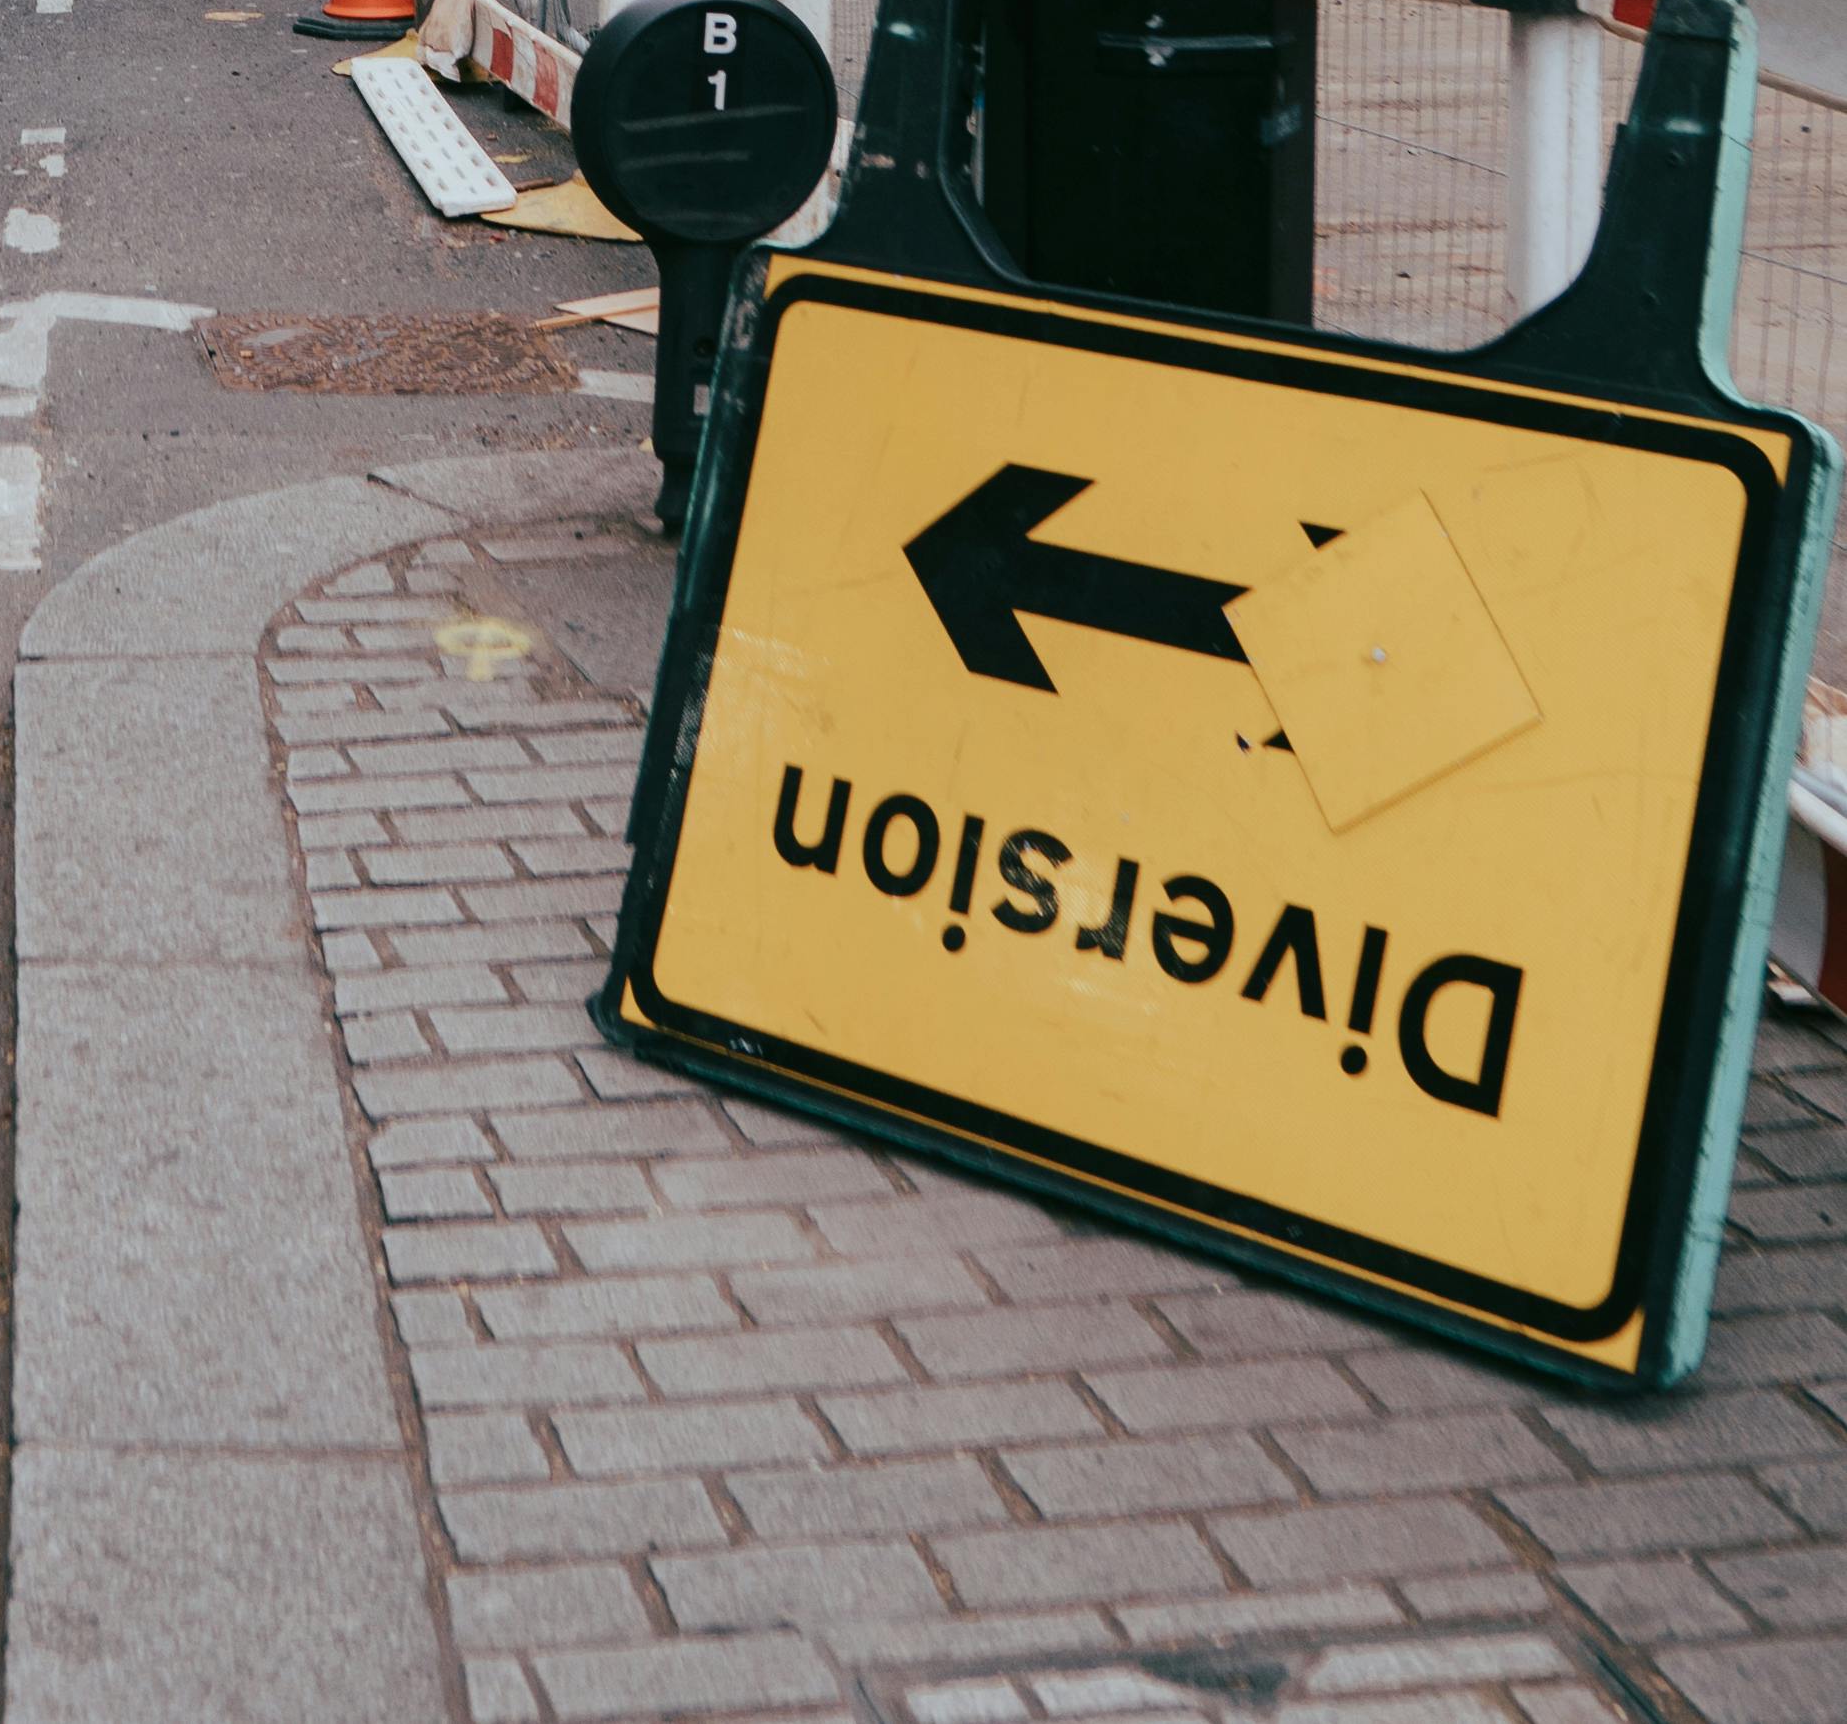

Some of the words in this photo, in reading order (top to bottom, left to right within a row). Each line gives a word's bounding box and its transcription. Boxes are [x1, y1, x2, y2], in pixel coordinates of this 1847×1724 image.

[704, 12, 738, 54] B
[707, 69, 727, 111] 1
[773, 762, 1526, 1117] Diversion
